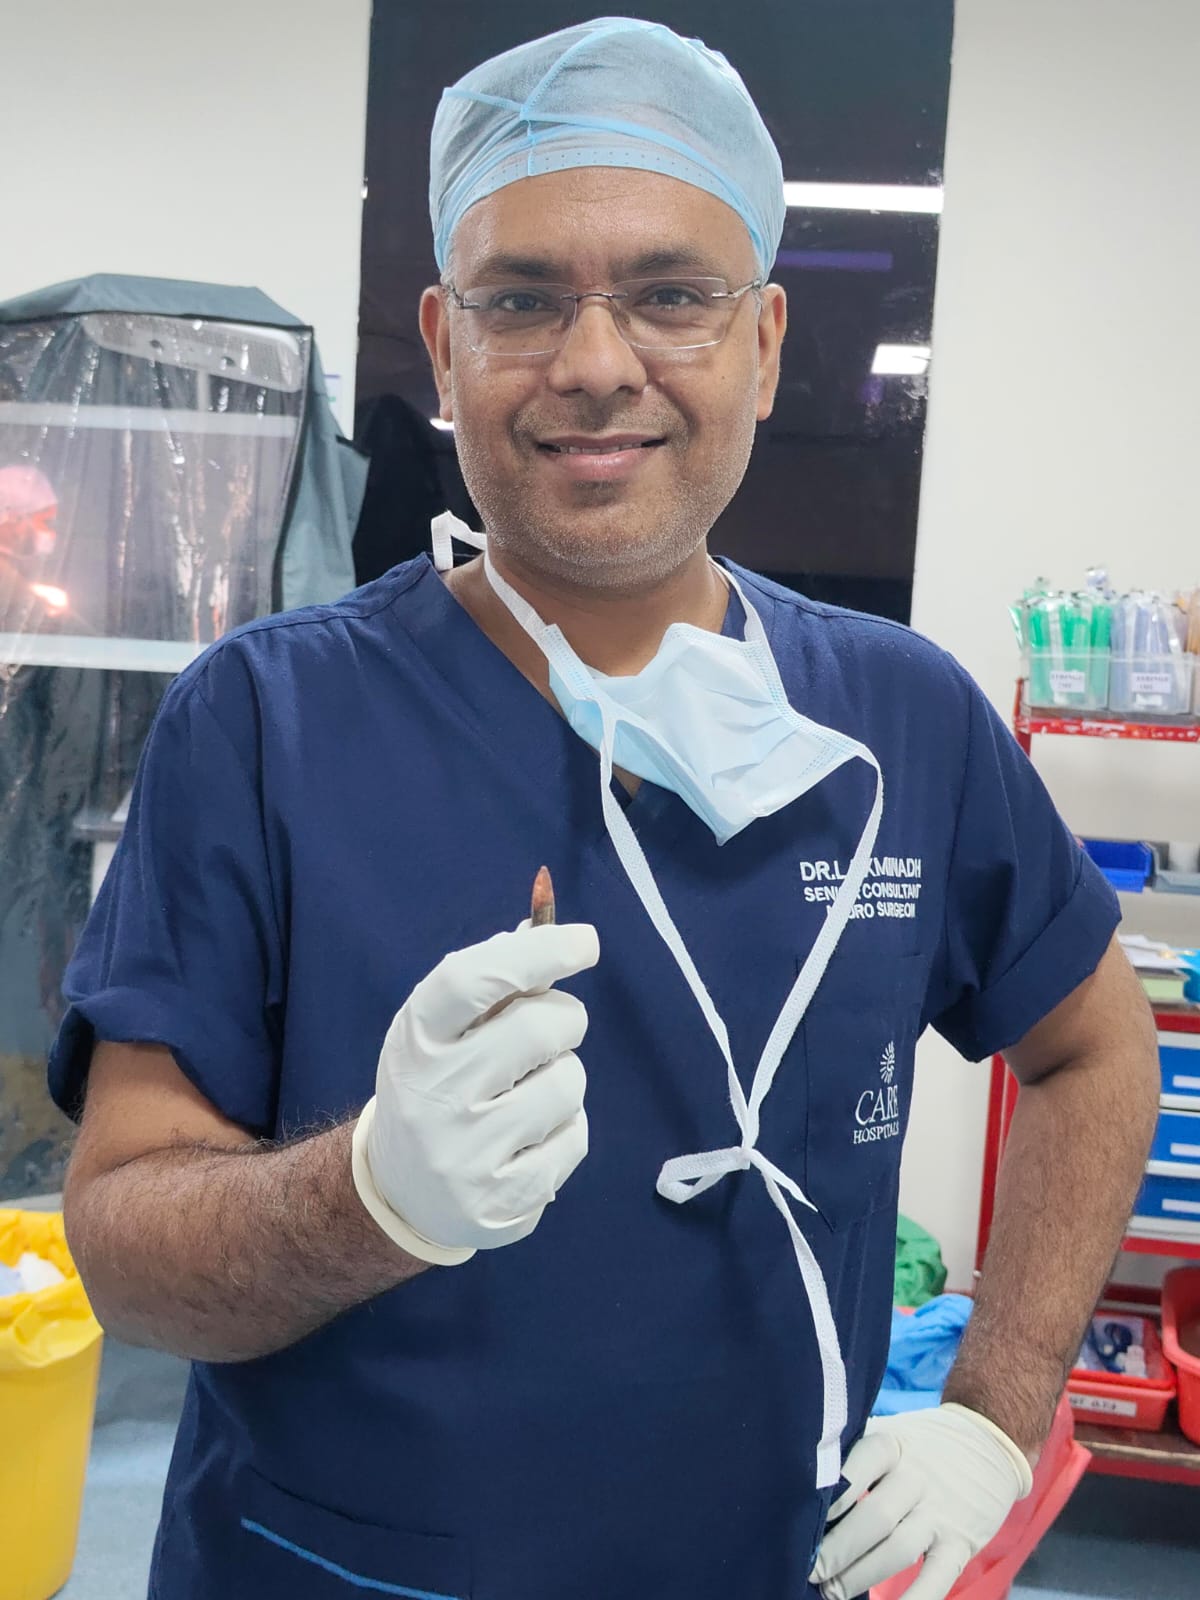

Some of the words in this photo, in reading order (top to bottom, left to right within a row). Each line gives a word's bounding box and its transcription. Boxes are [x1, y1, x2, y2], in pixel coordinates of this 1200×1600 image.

[862, 882, 922, 900] CONSULTANT
[876, 901, 916, 919] SURGEON
[855, 1085, 898, 1126] CARE
[853, 1121, 899, 1144] HOSPITALS
